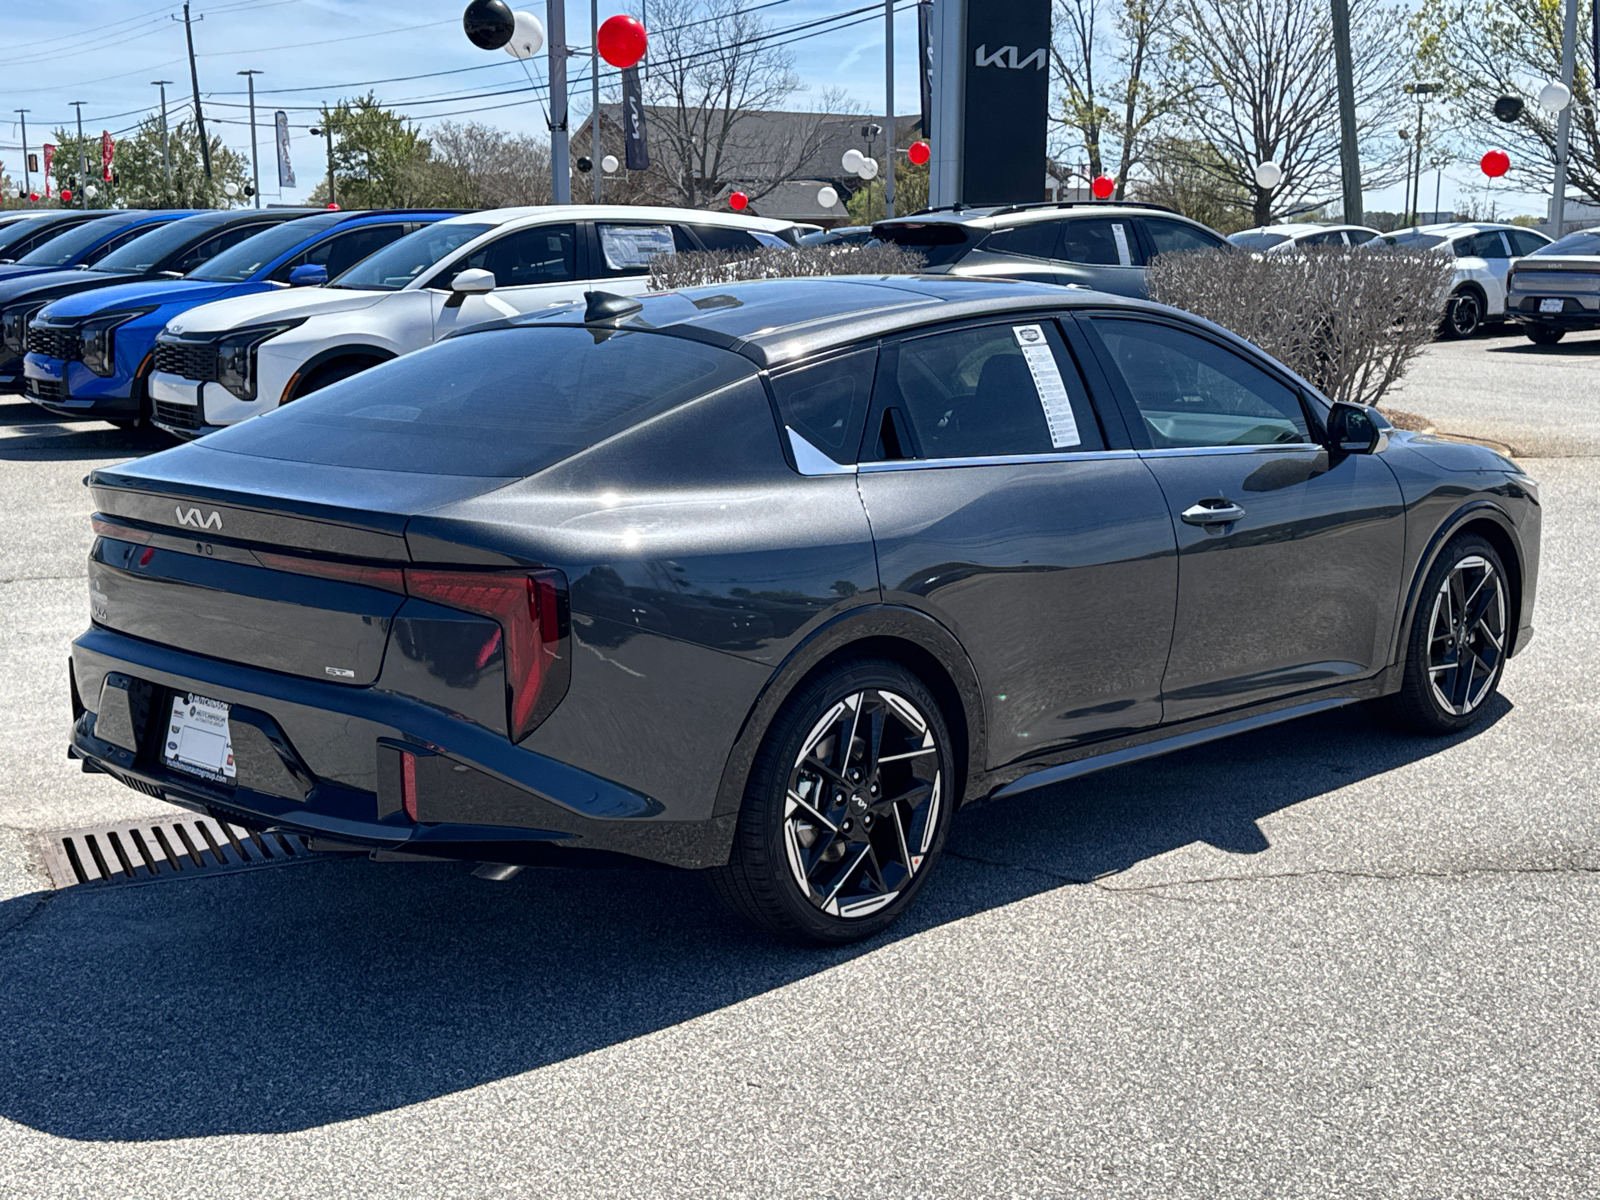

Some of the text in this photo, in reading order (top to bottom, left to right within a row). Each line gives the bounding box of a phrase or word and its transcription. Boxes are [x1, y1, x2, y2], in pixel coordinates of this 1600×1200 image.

[975, 44, 1047, 71] KIA
[175, 505, 223, 531] KIA
[915, 687, 947, 741] KUMHO
